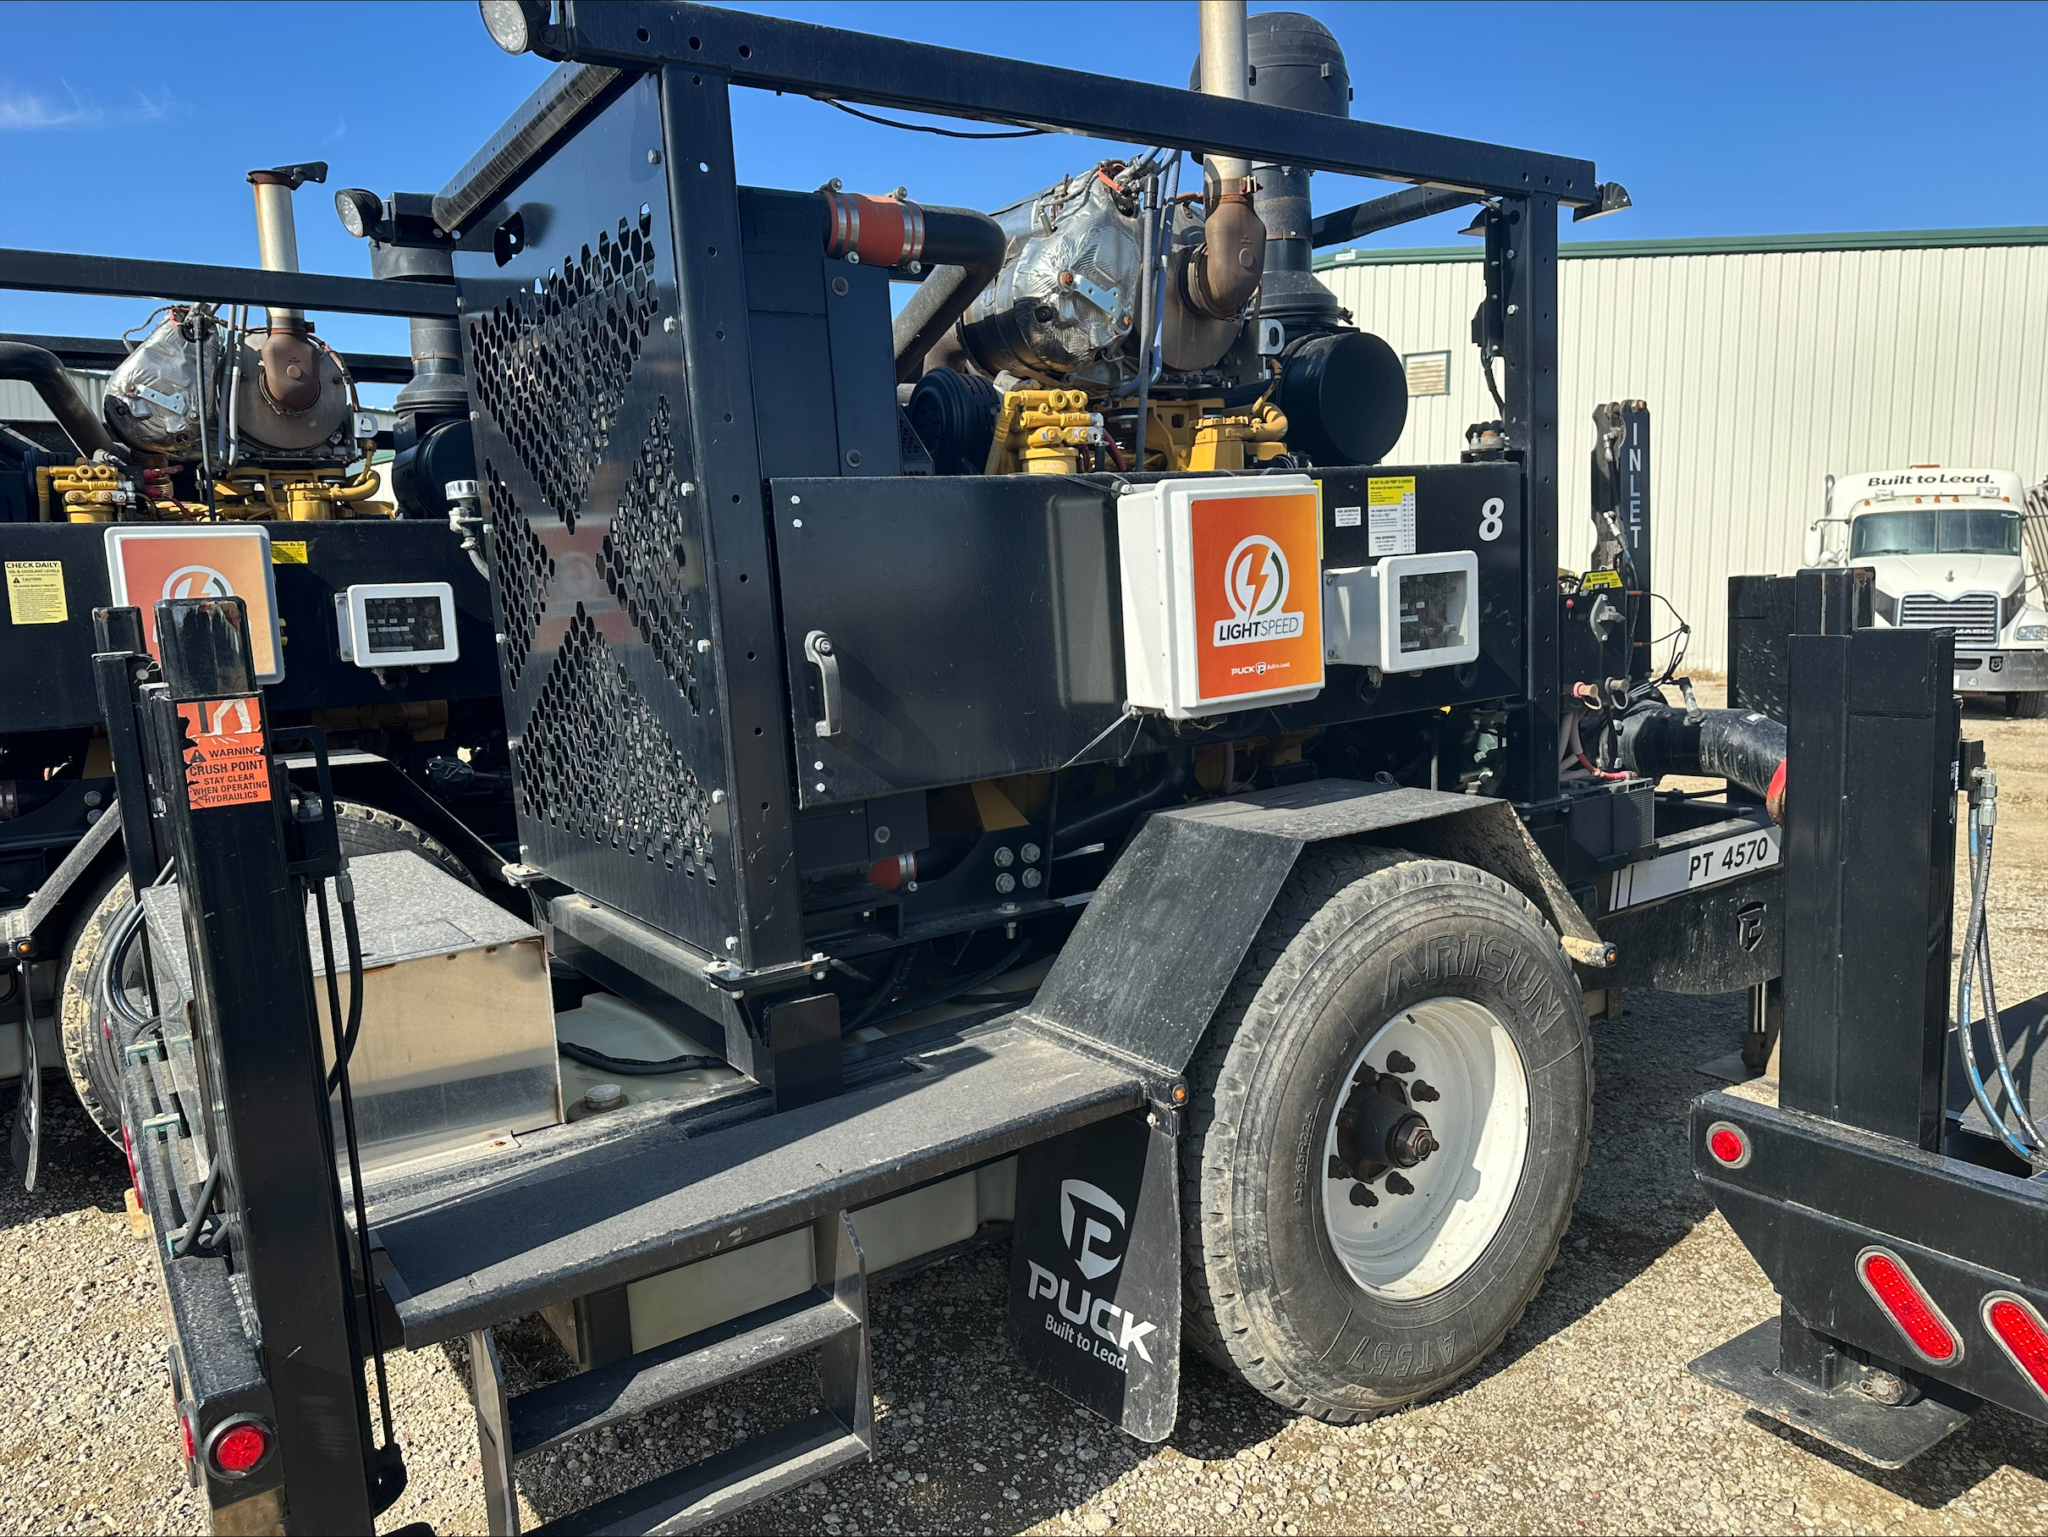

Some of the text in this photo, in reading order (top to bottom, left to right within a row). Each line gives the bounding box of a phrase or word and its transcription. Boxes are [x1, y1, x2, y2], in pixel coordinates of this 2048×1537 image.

[1629, 422, 1641, 549] INLET
[1868, 474, 1995, 487] Built to Lead.
[1479, 497, 1505, 541] 8
[1219, 617, 1299, 642] LIGHTSPEED
[1231, 665, 1255, 676] PUCK
[190, 760, 263, 776] CRUSH POINT
[204, 773, 255, 786] STAY CLEAR
[193, 781, 268, 795] WHEN OPERATING
[205, 791, 258, 803] HYDRAULICS
[1689, 837, 1768, 881] PT 4570
[1382, 931, 1565, 1038] ARISUN
[1027, 1258, 1157, 1365] PUCK
[1044, 1313, 1129, 1374] Built to Lead.
[1347, 1330, 1456, 1377] AT557
